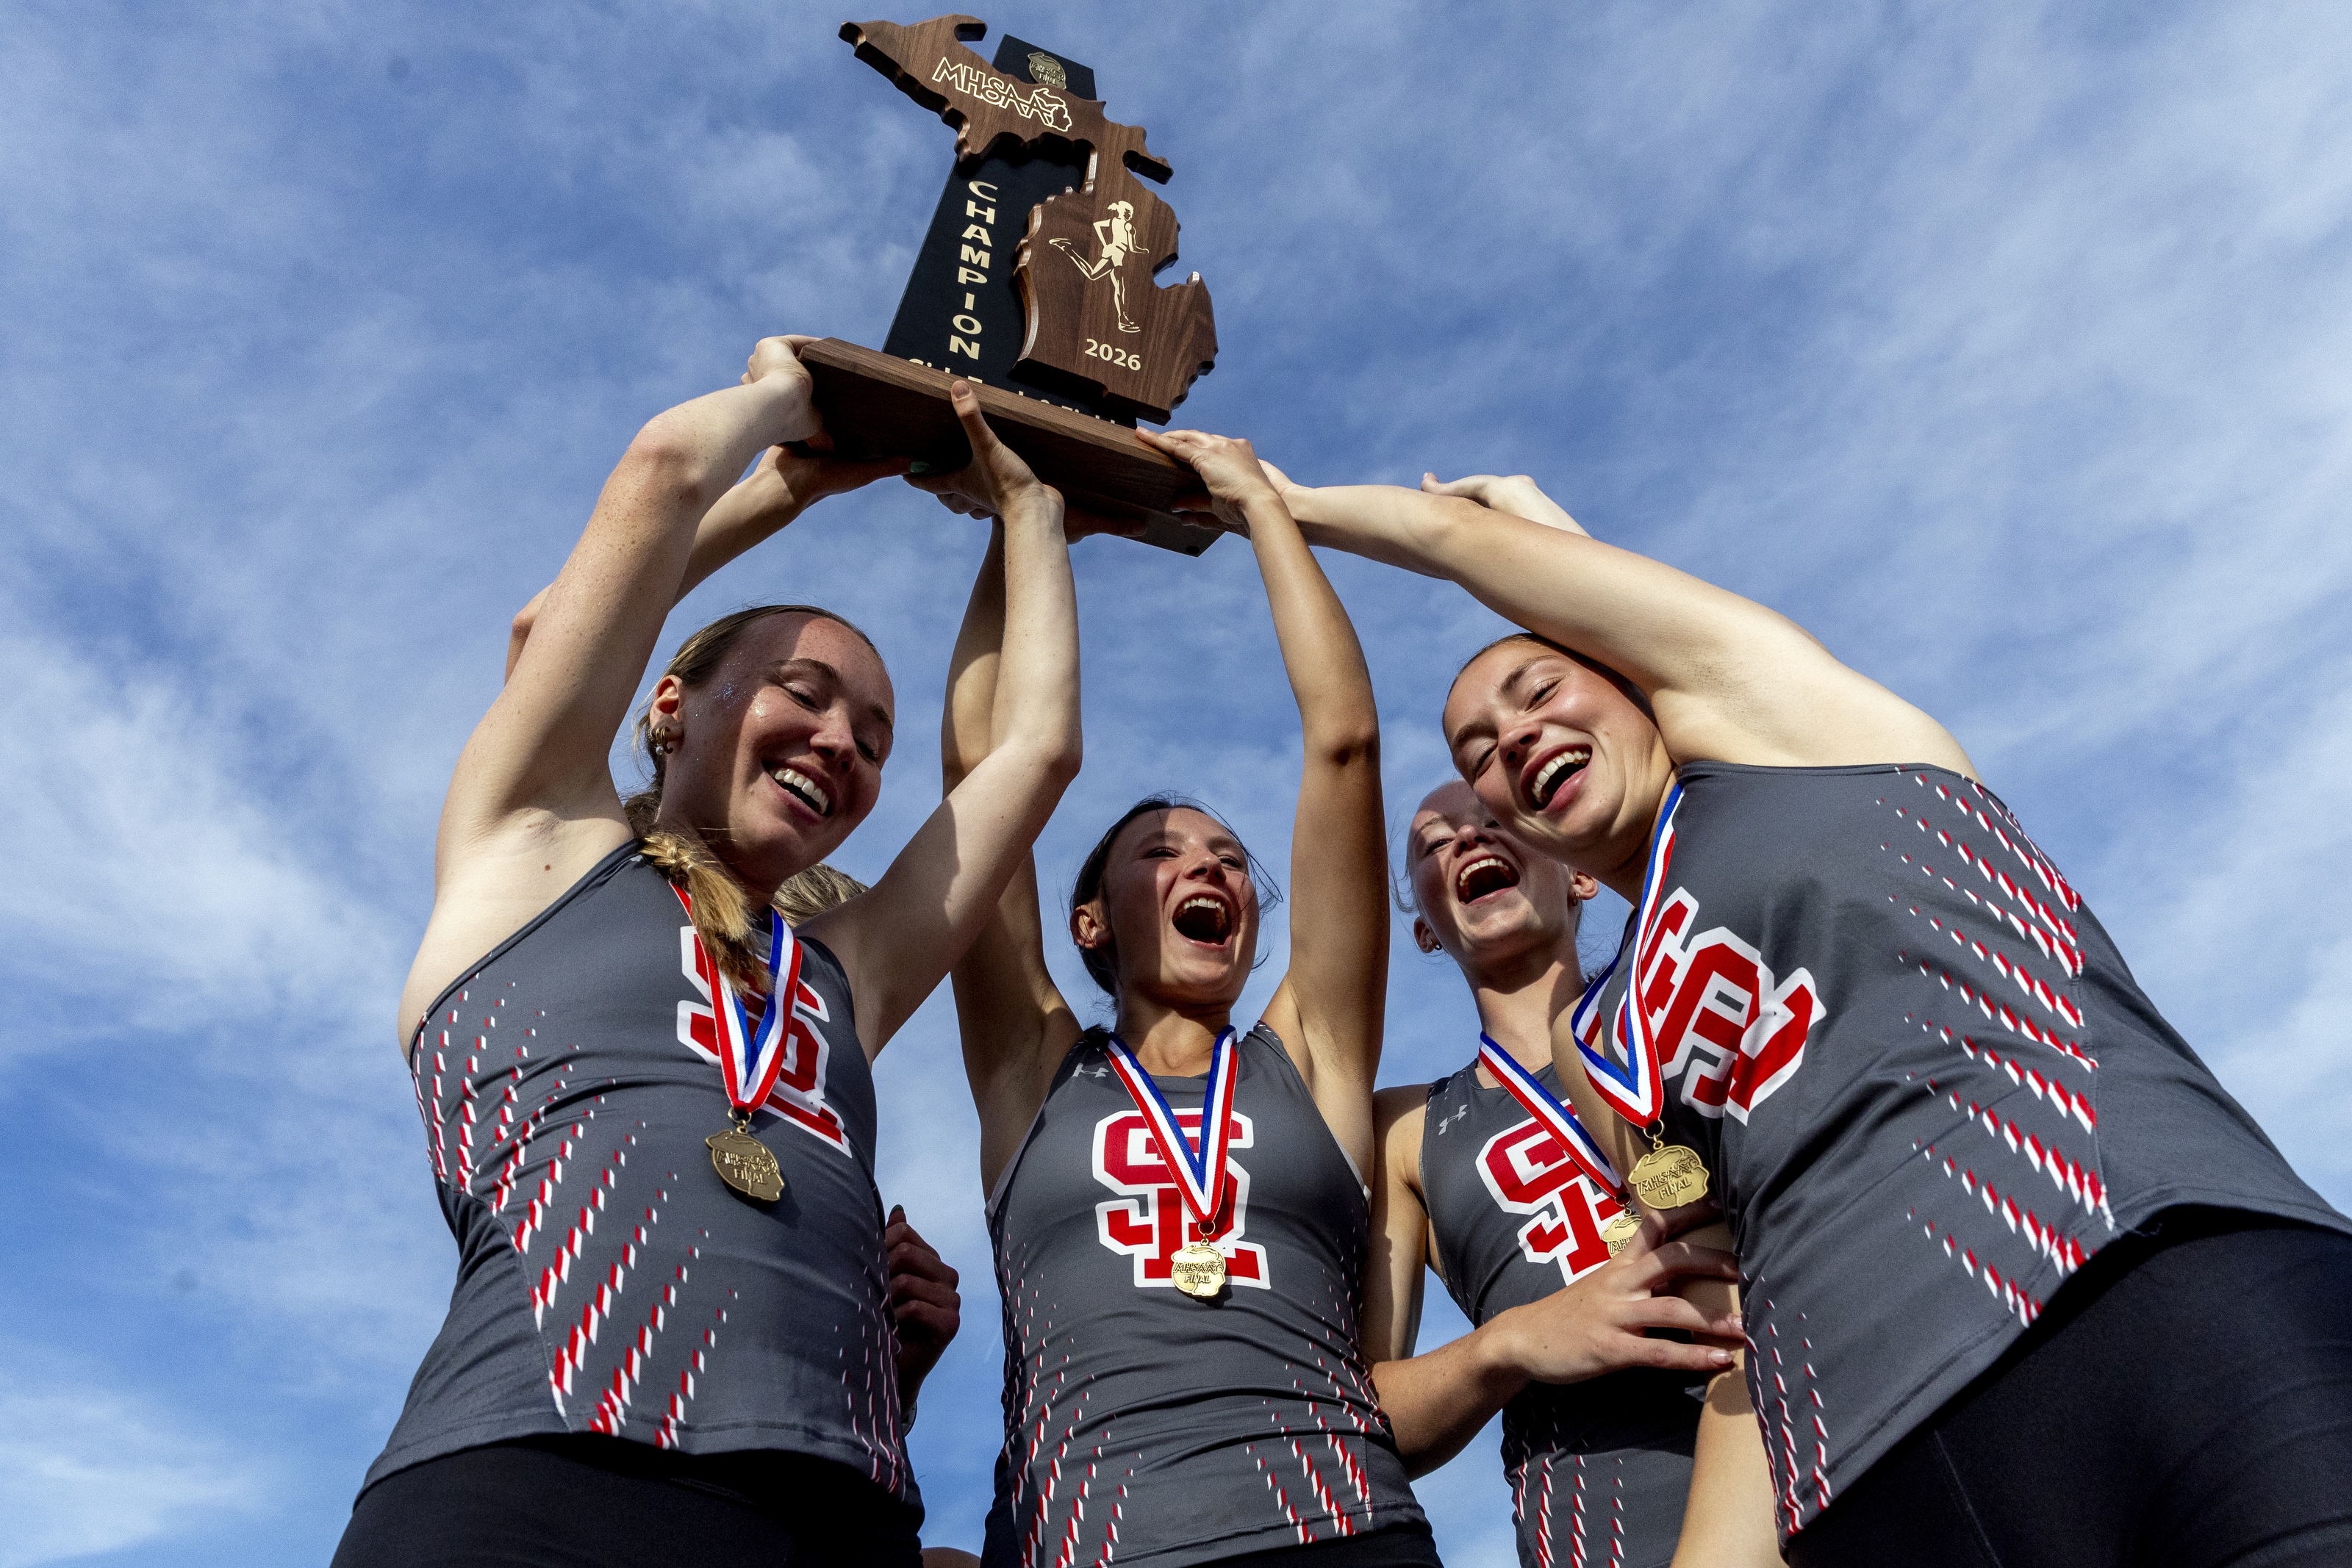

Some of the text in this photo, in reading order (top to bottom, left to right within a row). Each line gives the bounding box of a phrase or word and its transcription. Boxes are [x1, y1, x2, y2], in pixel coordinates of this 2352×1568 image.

[931, 57, 1053, 127] MHSAA
[949, 181, 998, 360] CHAMPION
[1085, 338, 1141, 370] 2026
[734, 1168, 767, 1184] FINAL
[1641, 1160, 1693, 1195] MHSAA
[1659, 1177, 1692, 1199] FINAL
[1174, 1262, 1216, 1273] MHSAA
[1184, 1275, 1211, 1284] FINAL
